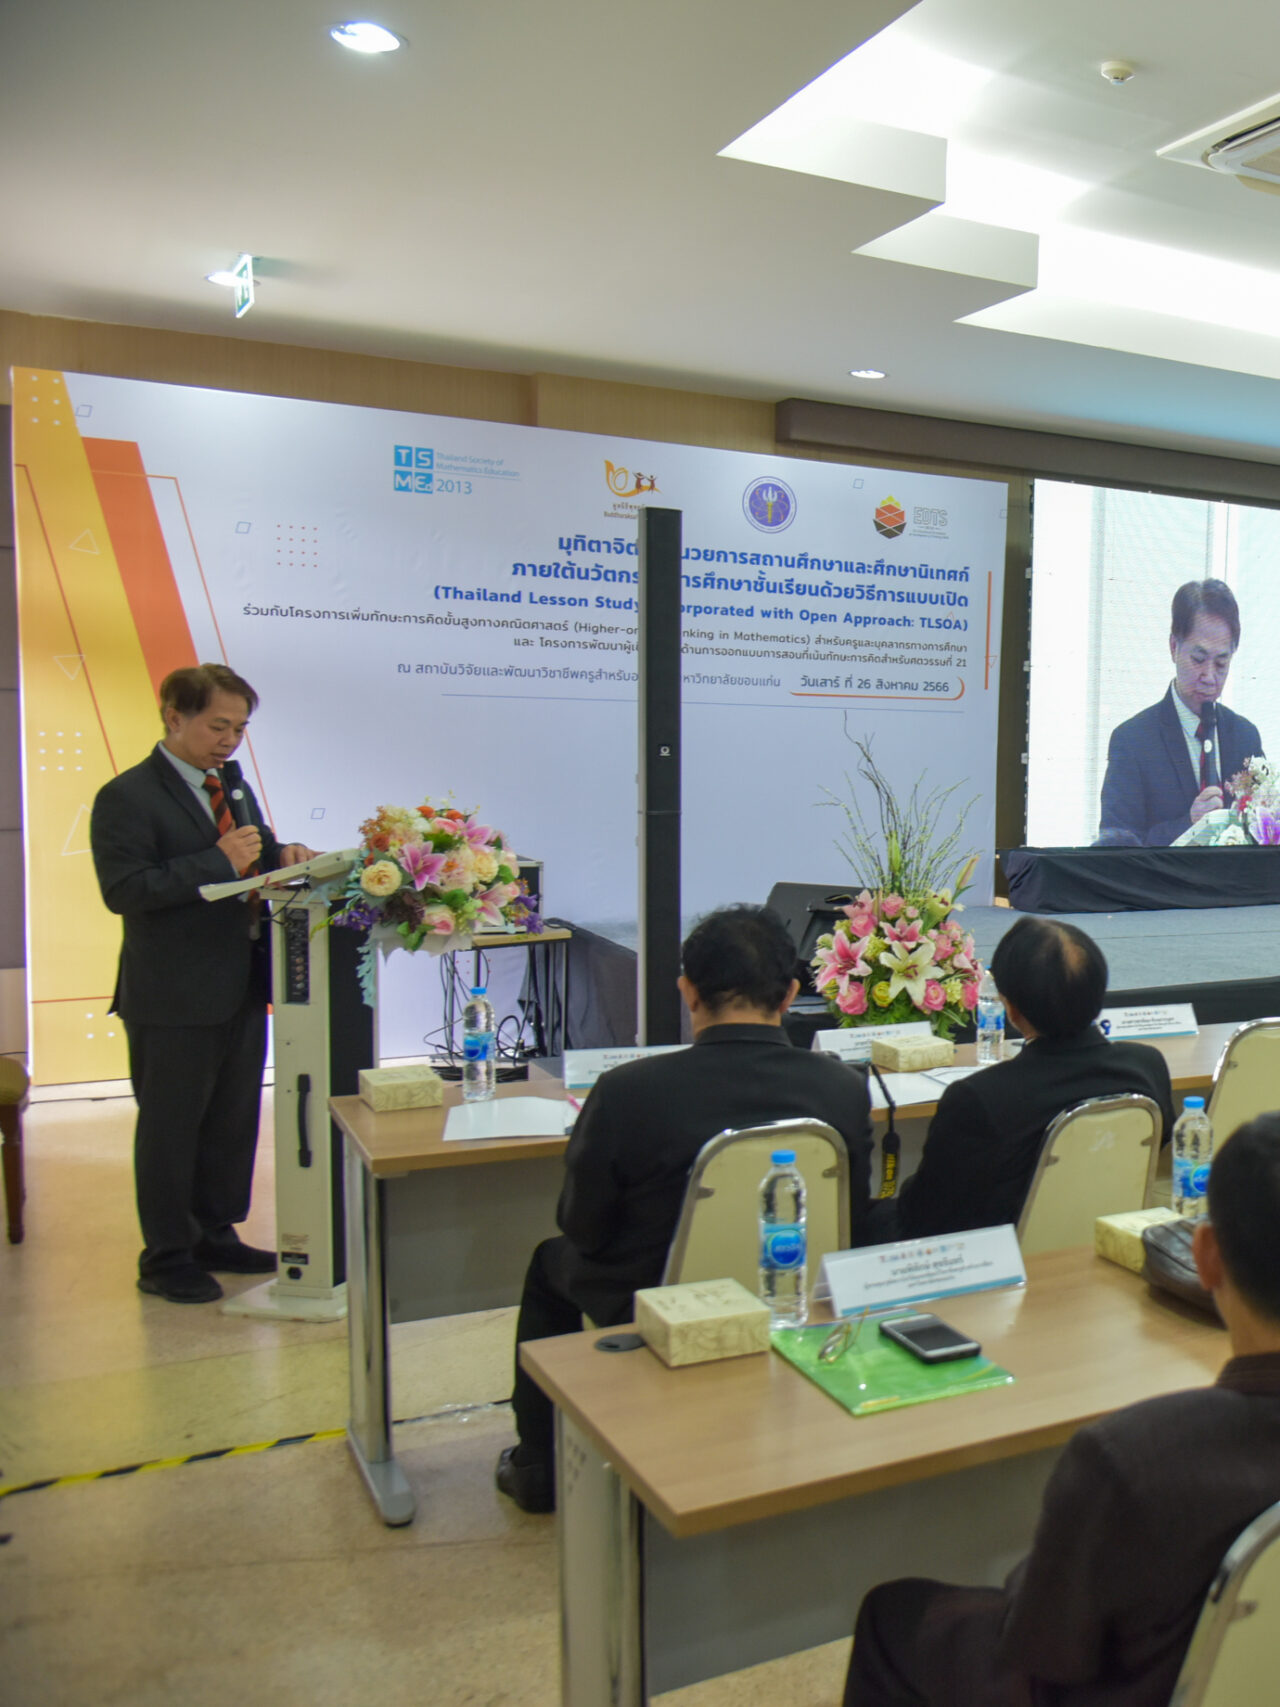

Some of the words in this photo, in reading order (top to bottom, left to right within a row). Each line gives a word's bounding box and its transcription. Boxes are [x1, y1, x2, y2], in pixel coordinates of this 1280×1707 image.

[436, 479, 473, 495] 2013
[681, 547, 970, 583] นวยการสถานศึกษาและศึกษานิเทศก์
[434, 585, 522, 604] (Thailand
[529, 591, 589, 608] Lesson
[681, 604, 754, 619] orporated
[760, 607, 793, 621] with
[799, 609, 837, 625] Open
[843, 612, 915, 628] Approach:
[920, 616, 968, 632] TLSOA)
[574, 621, 639, 636] (Higher-or
[682, 628, 714, 641] nking
[719, 630, 729, 640] in
[734, 631, 811, 646] Mathematics)
[514, 637, 535, 648] และ
[956, 657, 967, 668] 21
[397, 662, 411, 673] ณ
[415, 662, 639, 684] สถาบันวิจัยและพัฒนาวิชาชีพครูสำหรับอ
[683, 673, 781, 687] หาวิทยาลัยขอนแก่น
[801, 676, 840, 688] วันเสาร์
[845, 674, 853, 688] ที่
[857, 678, 871, 689] 26
[875, 677, 919, 691] สิงหาคม
[923, 681, 949, 692] 2566
